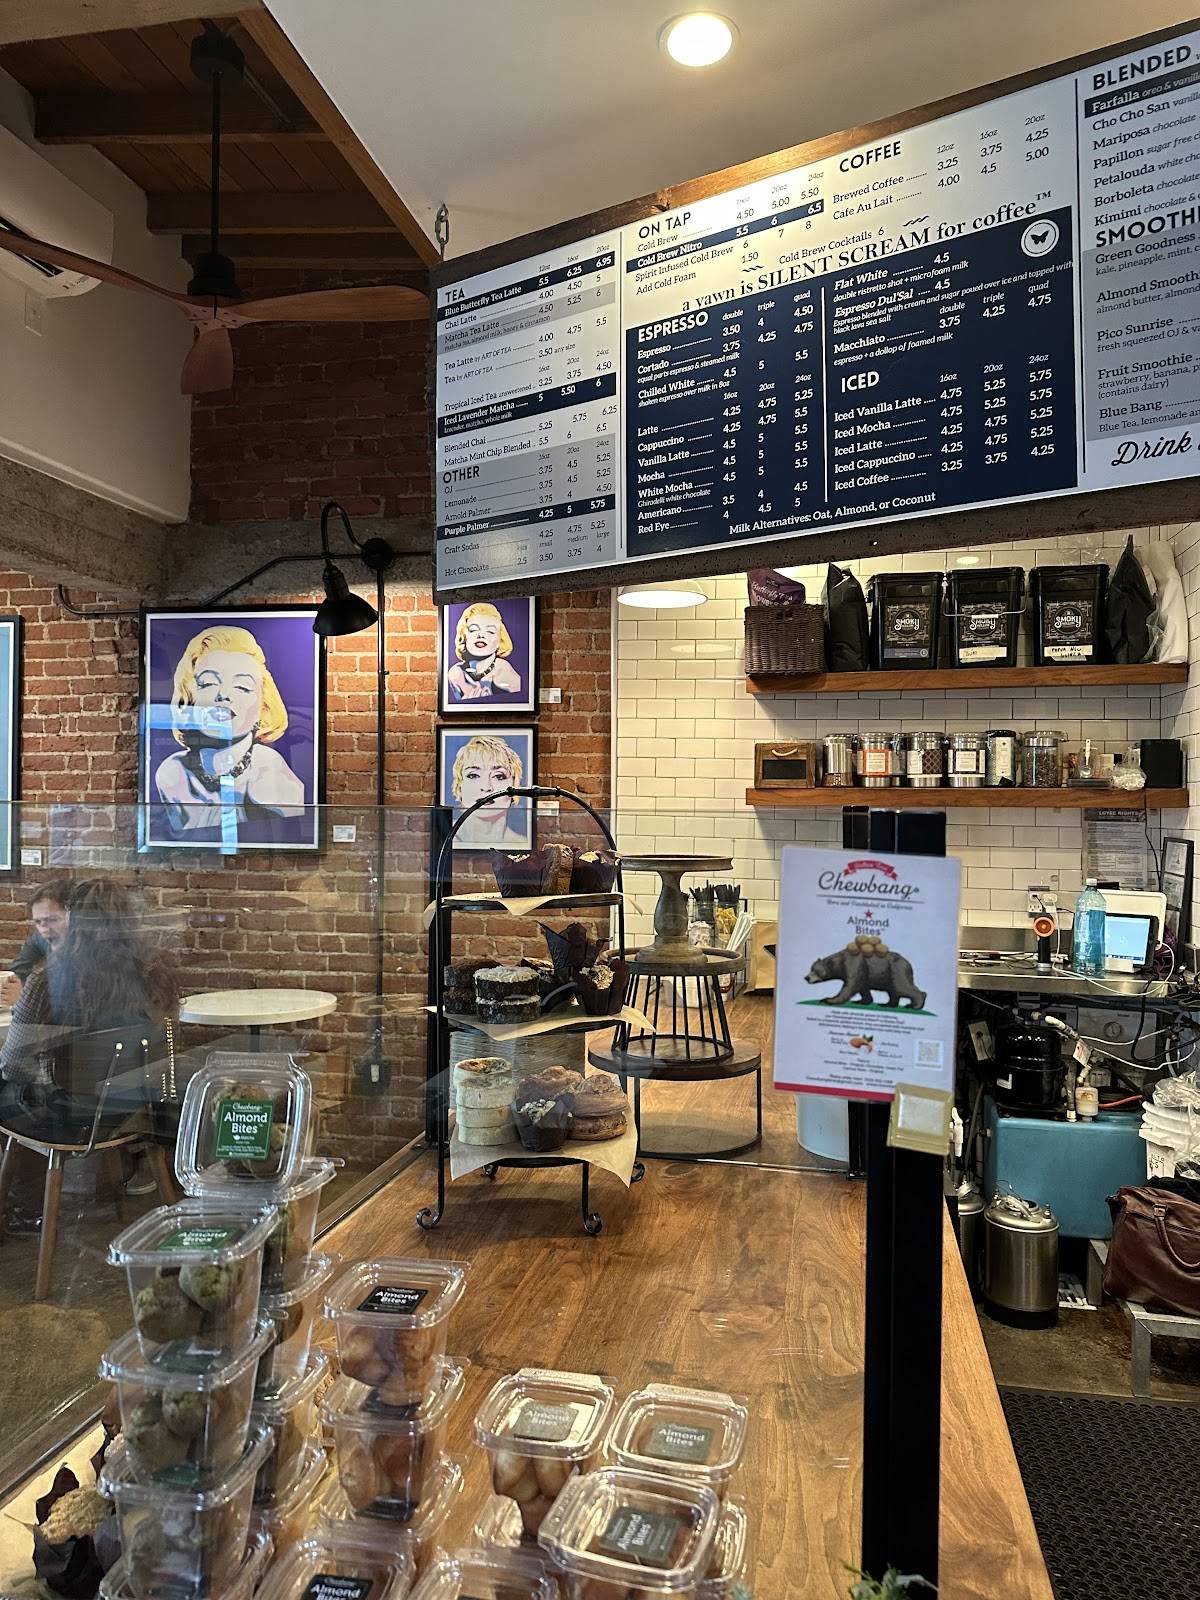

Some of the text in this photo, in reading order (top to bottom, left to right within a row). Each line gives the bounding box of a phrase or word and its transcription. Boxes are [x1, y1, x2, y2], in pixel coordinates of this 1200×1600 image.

[1093, 45, 1191, 90] BLENDED
[1092, 90, 1140, 113] Farfalla
[1092, 100, 1169, 130] Cho Cho San
[937, 113, 1045, 154] 12oz 16oz 20oz
[1092, 113, 1196, 150] Mariposa chocolate
[833, 129, 1049, 204] Brewed Coffee 3.25 3.75 4.25
[840, 141, 901, 172] COFFEE
[1093, 134, 1192, 169] Papillon sugar free
[833, 147, 1049, 220] Cafe Au Lait 4.00 4.5 5.00
[639, 212, 691, 239] ON TAP
[1094, 206, 1142, 226] Kimimi
[1144, 195, 1187, 213] chocolate
[635, 221, 811, 282] Spirit Infused Cold Brew 6 7 8
[638, 205, 821, 267] Cold Brew Nitro 5.5 6 6.5
[1096, 233, 1195, 263] Green Goodness
[636, 252, 758, 295] Add Cold Foam 1.50
[682, 301, 690, 311] a
[696, 288, 735, 307] yawn
[741, 280, 753, 296] is
[758, 255, 831, 291] SILENT
[838, 227, 931, 268] SCREAM
[937, 218, 966, 240] for
[834, 252, 949, 290] Flat White 4.5
[1096, 248, 1192, 276] kale, pineapple, mint,
[445, 257, 611, 316] Blue Butterfly Tea Latte 5.5 6.25 6.95
[445, 288, 465, 303] TEA
[833, 289, 857, 302] double
[858, 283, 886, 296] ristretto
[888, 278, 902, 288] shot
[910, 268, 950, 282] microfoam
[952, 260, 969, 273] milk
[1097, 282, 1146, 302] Almond
[638, 311, 708, 342] ESPRESSO
[834, 294, 1051, 353] Macchiato 3.75 4.25 4.75
[1097, 318, 1173, 341] Pico Sunrise
[841, 371, 880, 392] ICED
[1098, 353, 1192, 379] Fruit Smoothie
[444, 415, 456, 425] Iced
[458, 408, 488, 423] Lavender
[489, 402, 514, 416] Matcha
[562, 386, 575, 395] 5.50
[596, 379, 601, 387] 6
[835, 369, 1052, 422] Iced Vanilla Latte 4.75 5.25 5.75
[1098, 379, 1169, 400] (contains dairy)
[1099, 401, 1162, 418] Blue Bang
[638, 407, 808, 452] Cappuccino 4.25 4.75 5.5
[1112, 431, 1192, 466] Drink
[443, 466, 479, 483] OTHER
[835, 444, 1054, 491] Iced Coffee 3.25 3.75 4.25
[444, 500, 605, 536] Purple Palmer 4.25 5 5.75
[638, 481, 808, 520] Americano 3.5 4 4.5
[729, 492, 936, 534] Milk Alternatives: Oat, Almond, or Coconut
[819, 871, 913, 899] Chewbang
[847, 916, 889, 927] Almond
[224, 1112, 267, 1123] Almond
[376, 1291, 419, 1300] Almond
[659, 1428, 705, 1441] Almond
[621, 1513, 643, 1550] Almond
[311, 1584, 361, 1598] Almond
